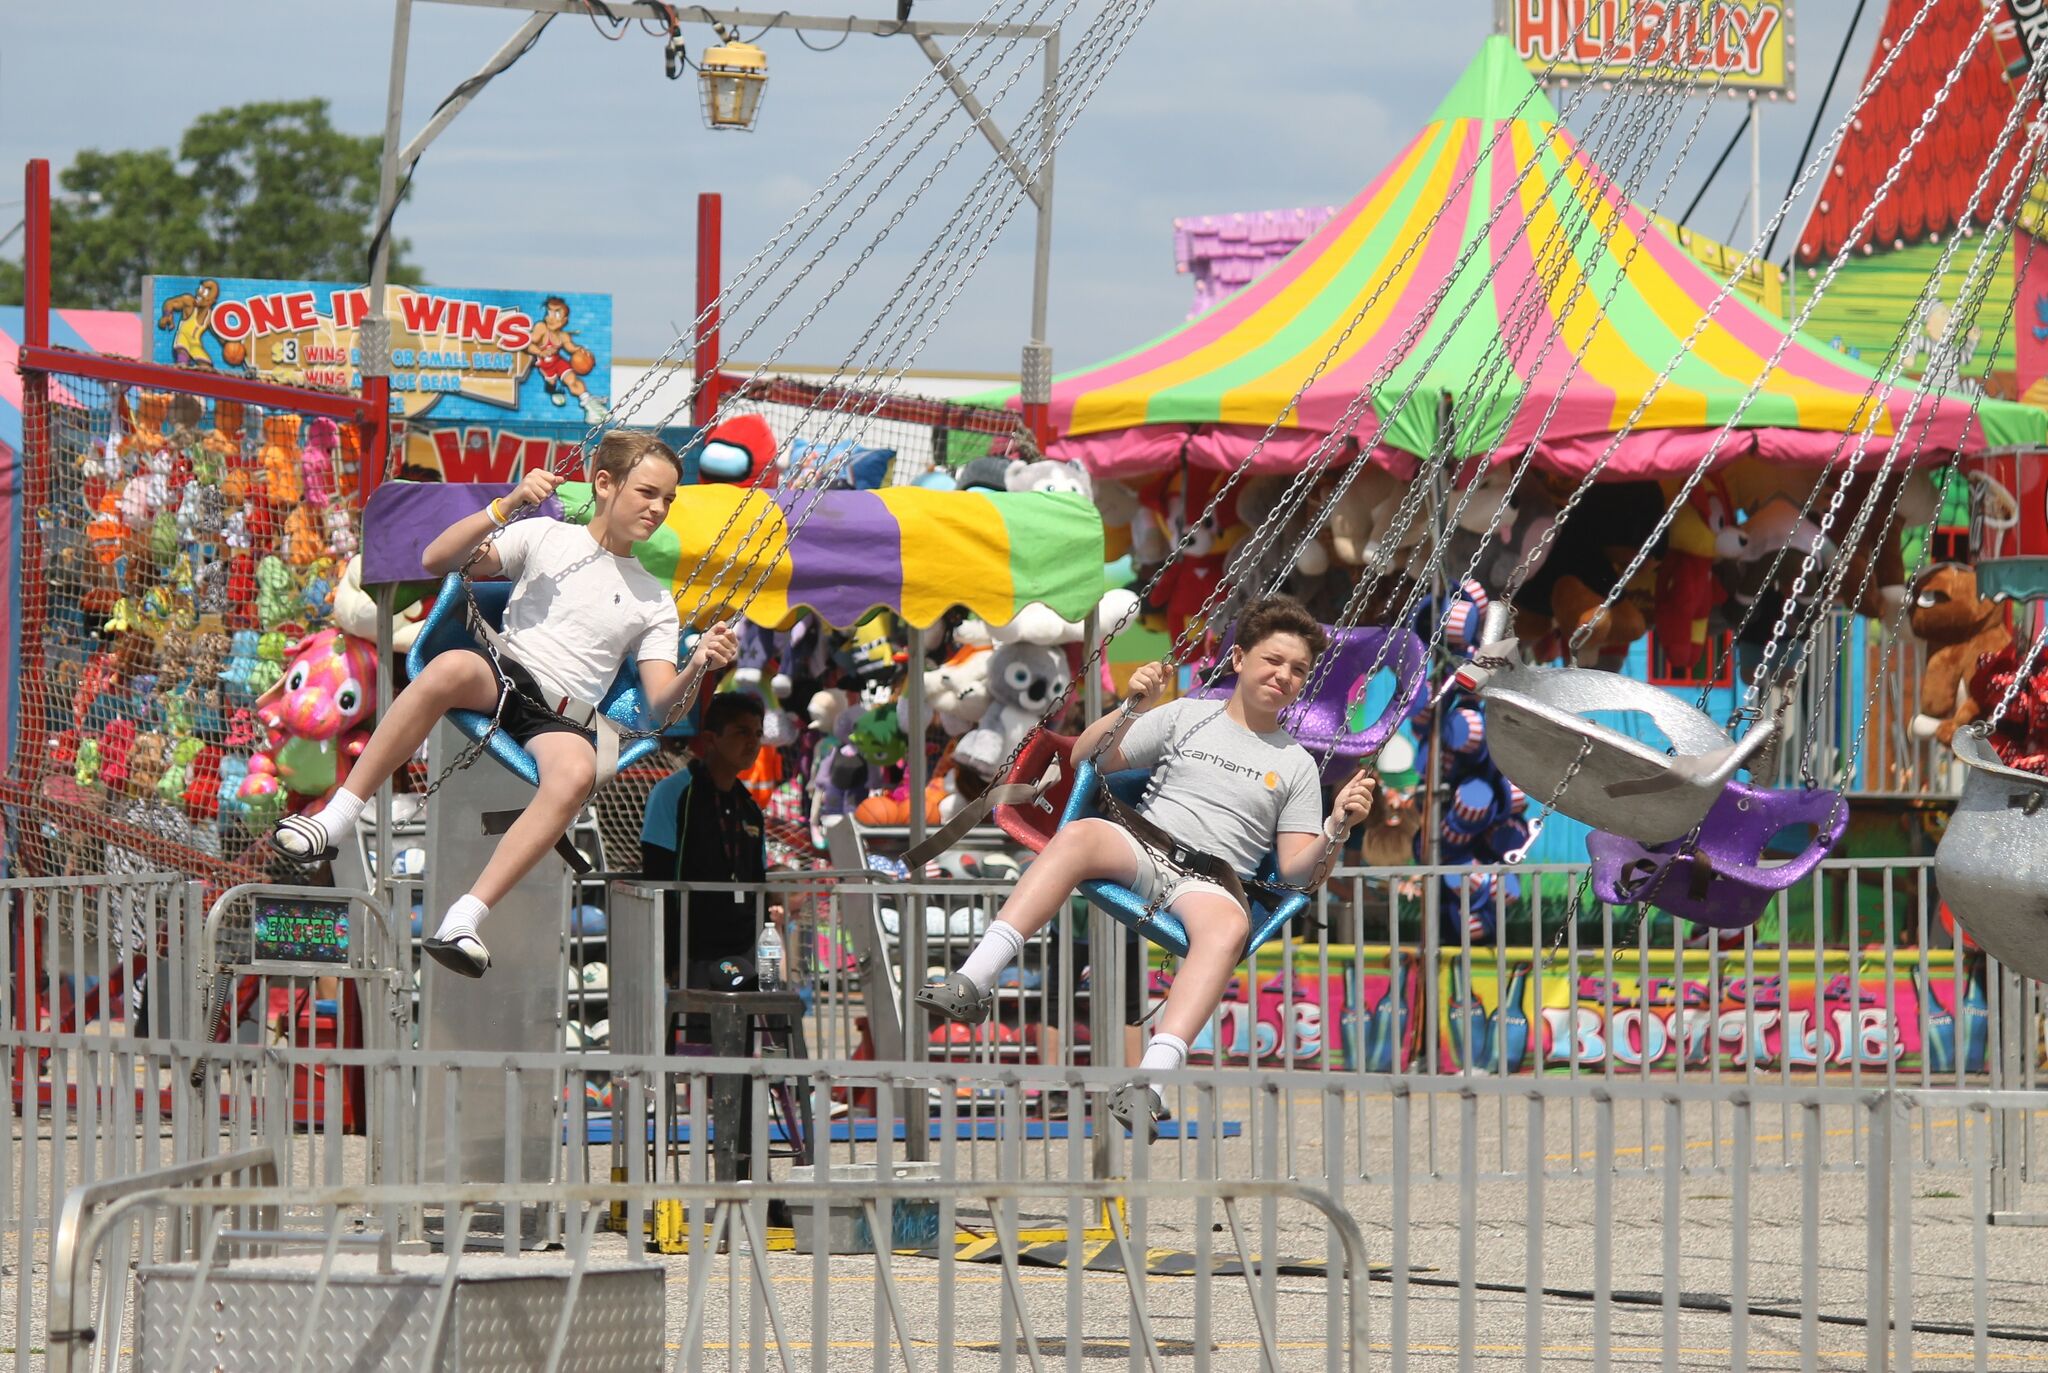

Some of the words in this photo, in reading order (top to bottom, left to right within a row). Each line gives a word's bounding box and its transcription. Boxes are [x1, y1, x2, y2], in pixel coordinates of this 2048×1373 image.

[1515, 0, 1780, 74] HILLBILLY
[212, 291, 320, 341] ONE
[398, 294, 533, 350] WINS
[303, 346, 347, 364] WINS
[391, 349, 414, 367] OR
[418, 351, 470, 369] SMALL
[303, 371, 346, 387] WINS
[420, 374, 461, 391] BEAR
[1181, 749, 1262, 780] carhartt
[266, 916, 336, 944] ENTER
[1542, 1008, 1905, 1066] BOTTLE
